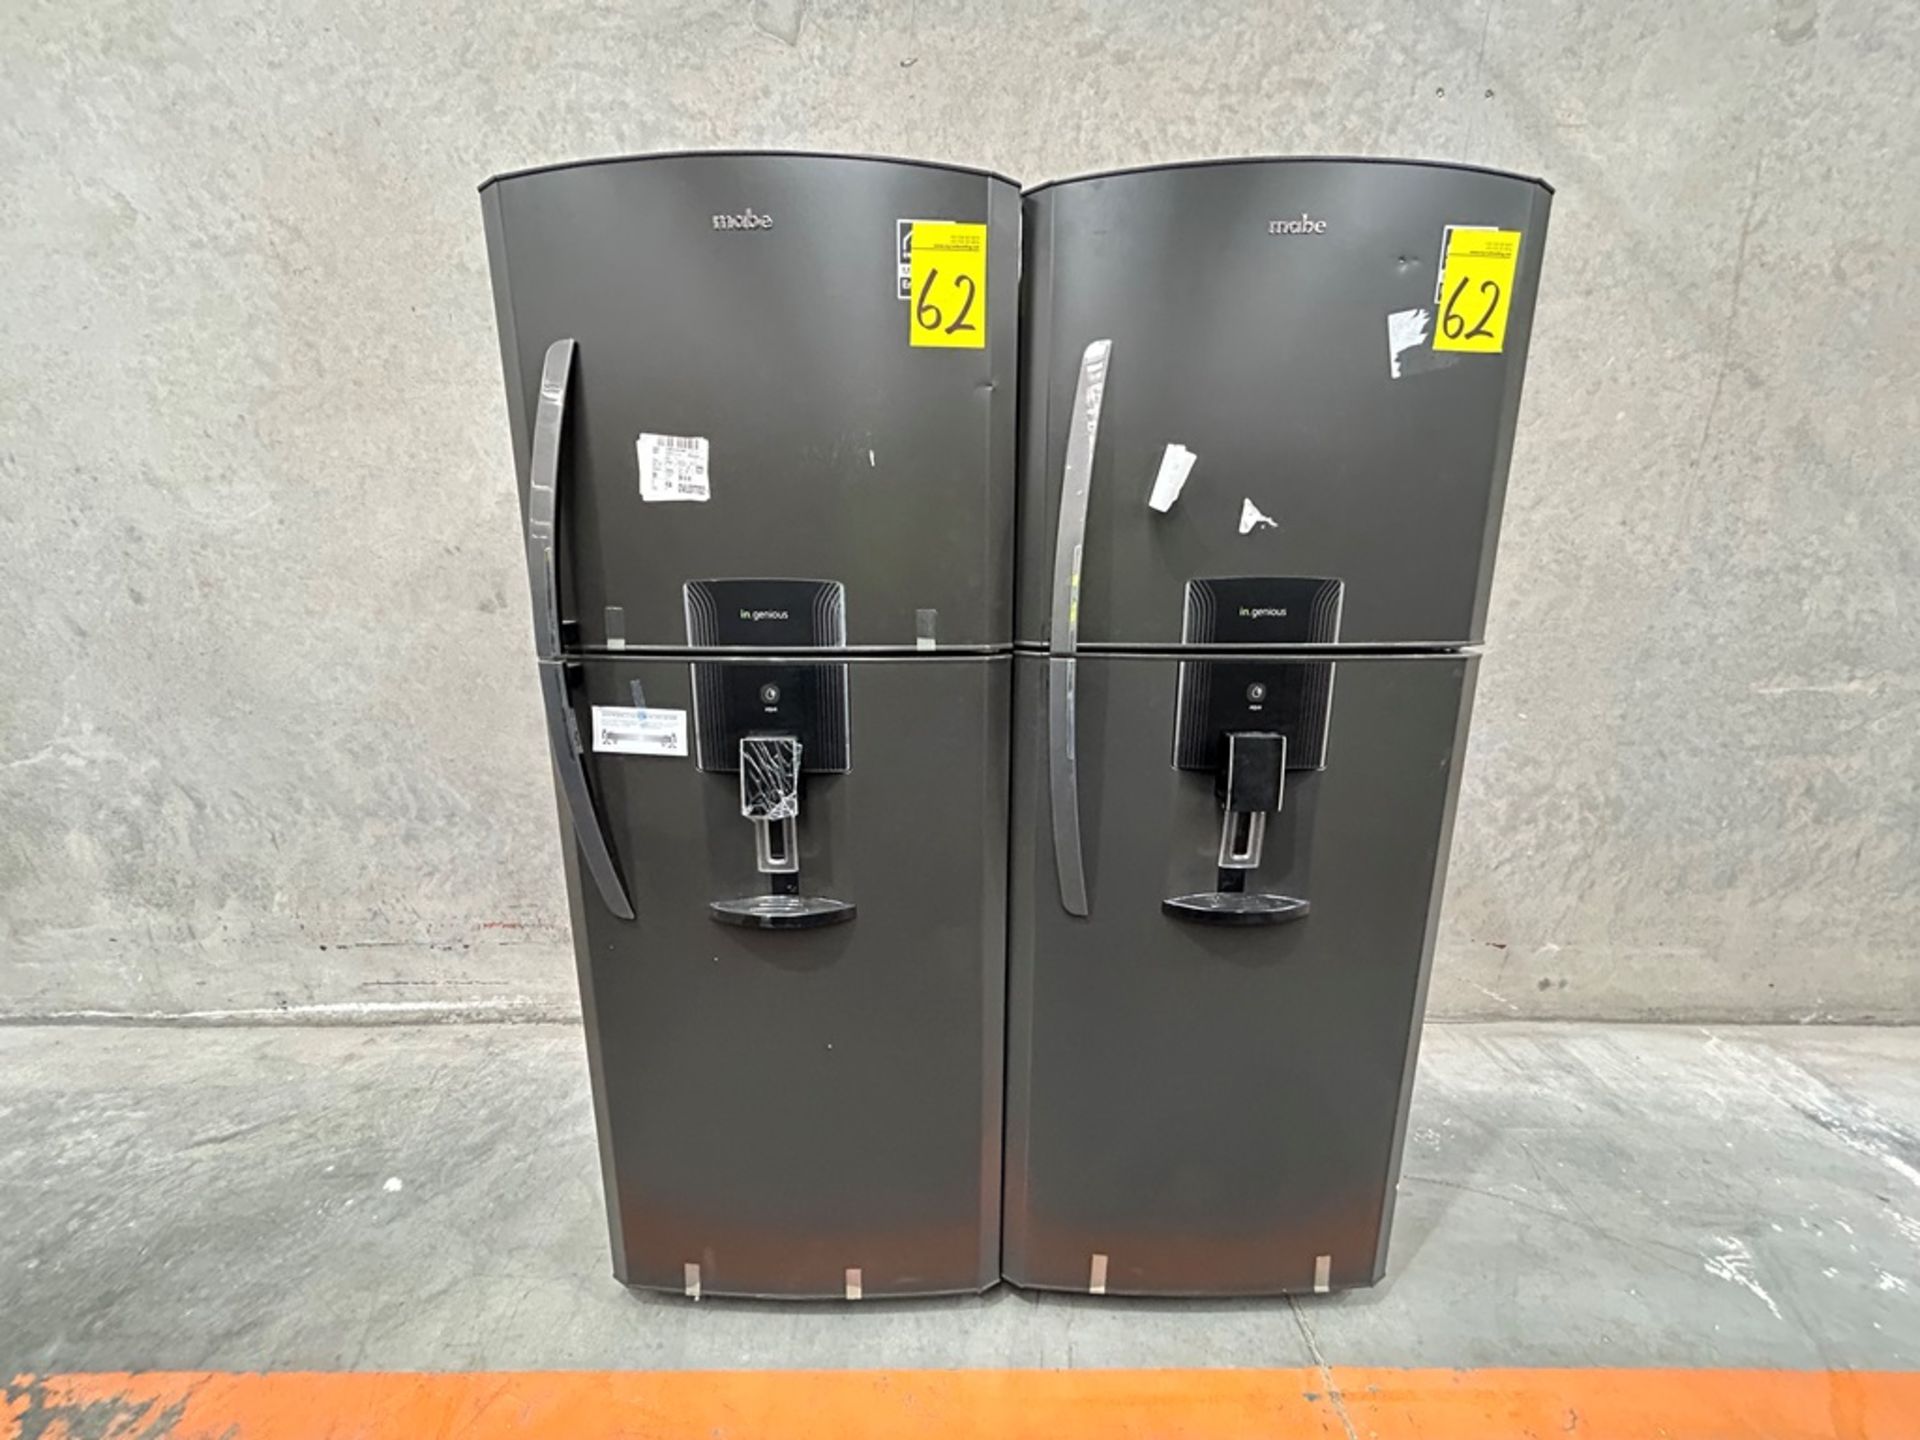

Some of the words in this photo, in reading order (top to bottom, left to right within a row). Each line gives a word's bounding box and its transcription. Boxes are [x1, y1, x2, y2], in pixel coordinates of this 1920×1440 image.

[712, 207, 774, 230] mabe
[1268, 213, 1327, 234] mabe
[916, 268, 976, 335] 62
[1443, 276, 1500, 340] 62
